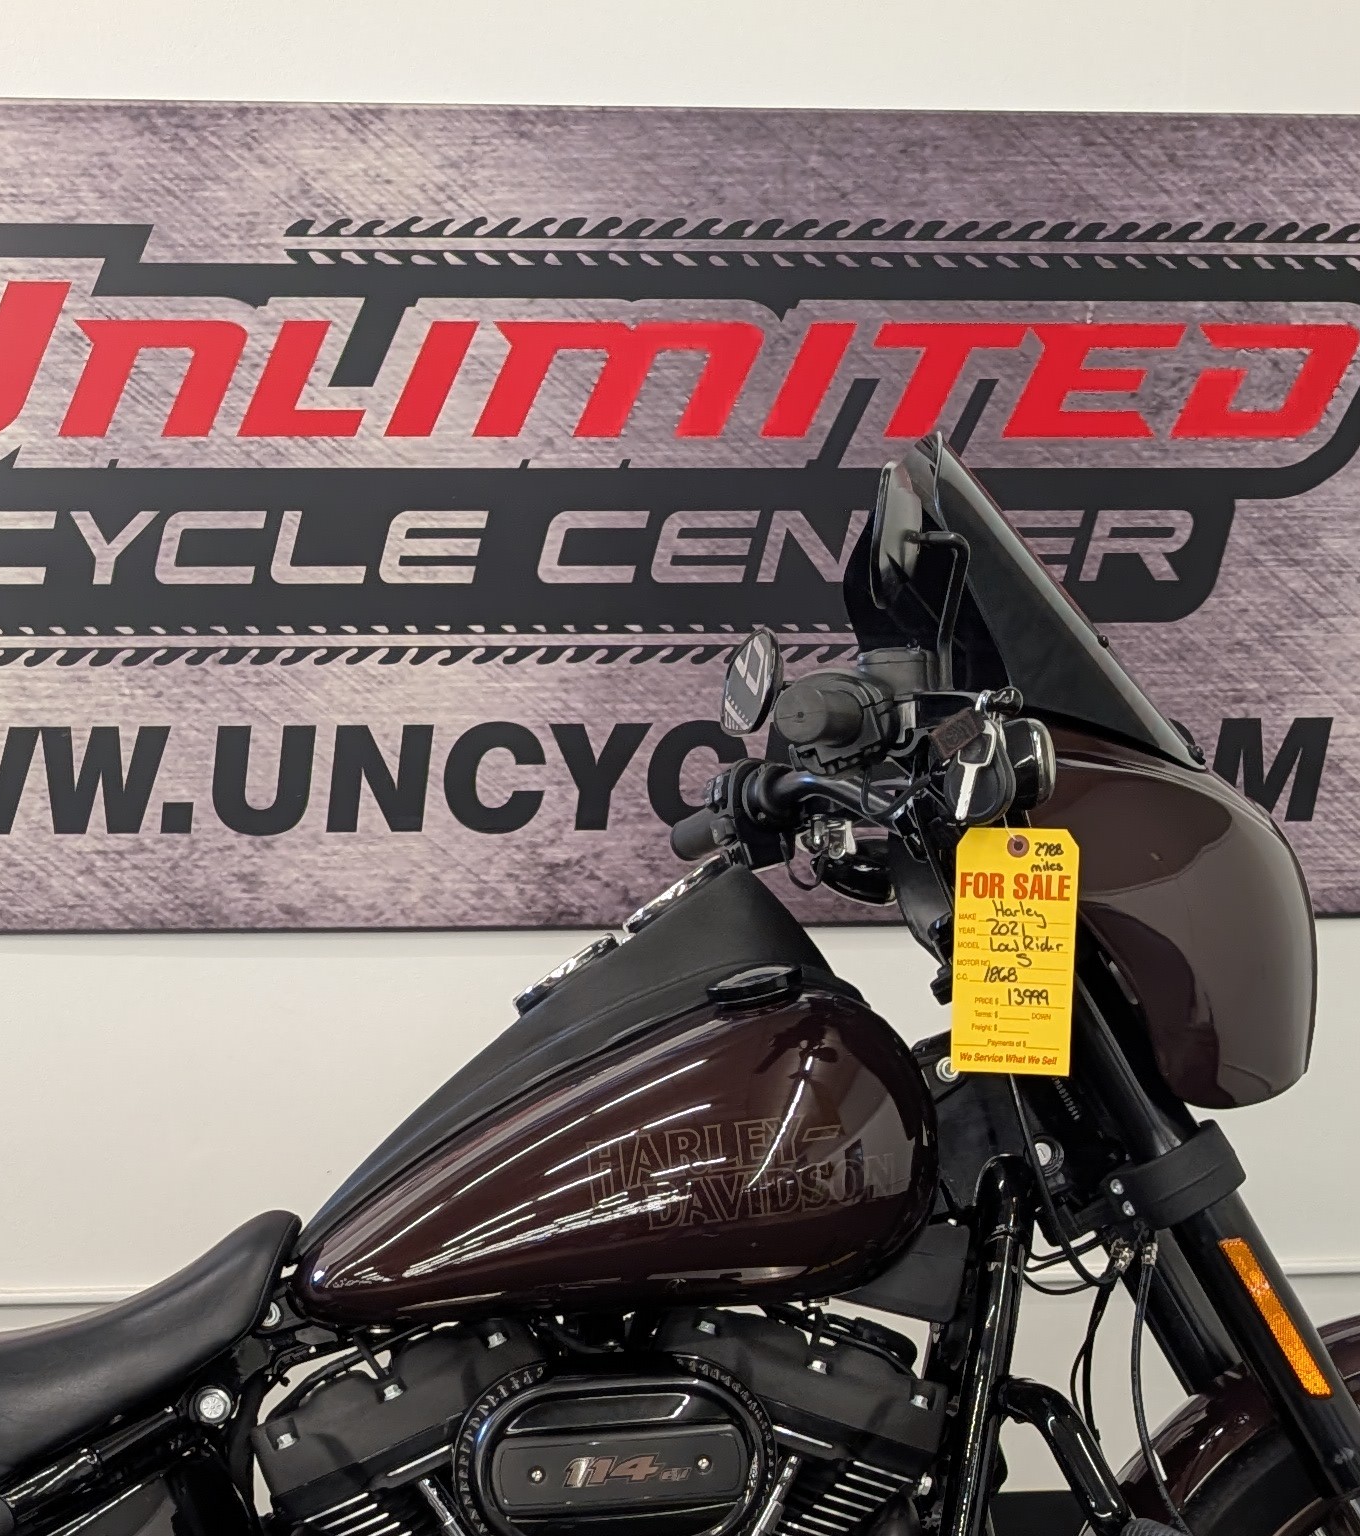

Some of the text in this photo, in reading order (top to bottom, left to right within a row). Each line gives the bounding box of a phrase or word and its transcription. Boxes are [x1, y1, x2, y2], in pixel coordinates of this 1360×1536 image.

[536, 509, 1195, 583] CENER
[959, 872, 1072, 902] FOR SALE
[957, 917, 1026, 937] YEAR 2021
[958, 899, 1047, 930] MAKE Harley
[957, 941, 980, 950] MODEL
[989, 936, 1020, 953] Low
[1015, 952, 1033, 968] S
[974, 996, 994, 1006] PRICE
[1007, 987, 1050, 1007] 13999
[959, 1051, 1058, 1067] We Service What We Sell
[585, 1115, 842, 1206] HARLEY-
[642, 1153, 893, 1231] DAVIDSON
[562, 1452, 666, 1489] 114
